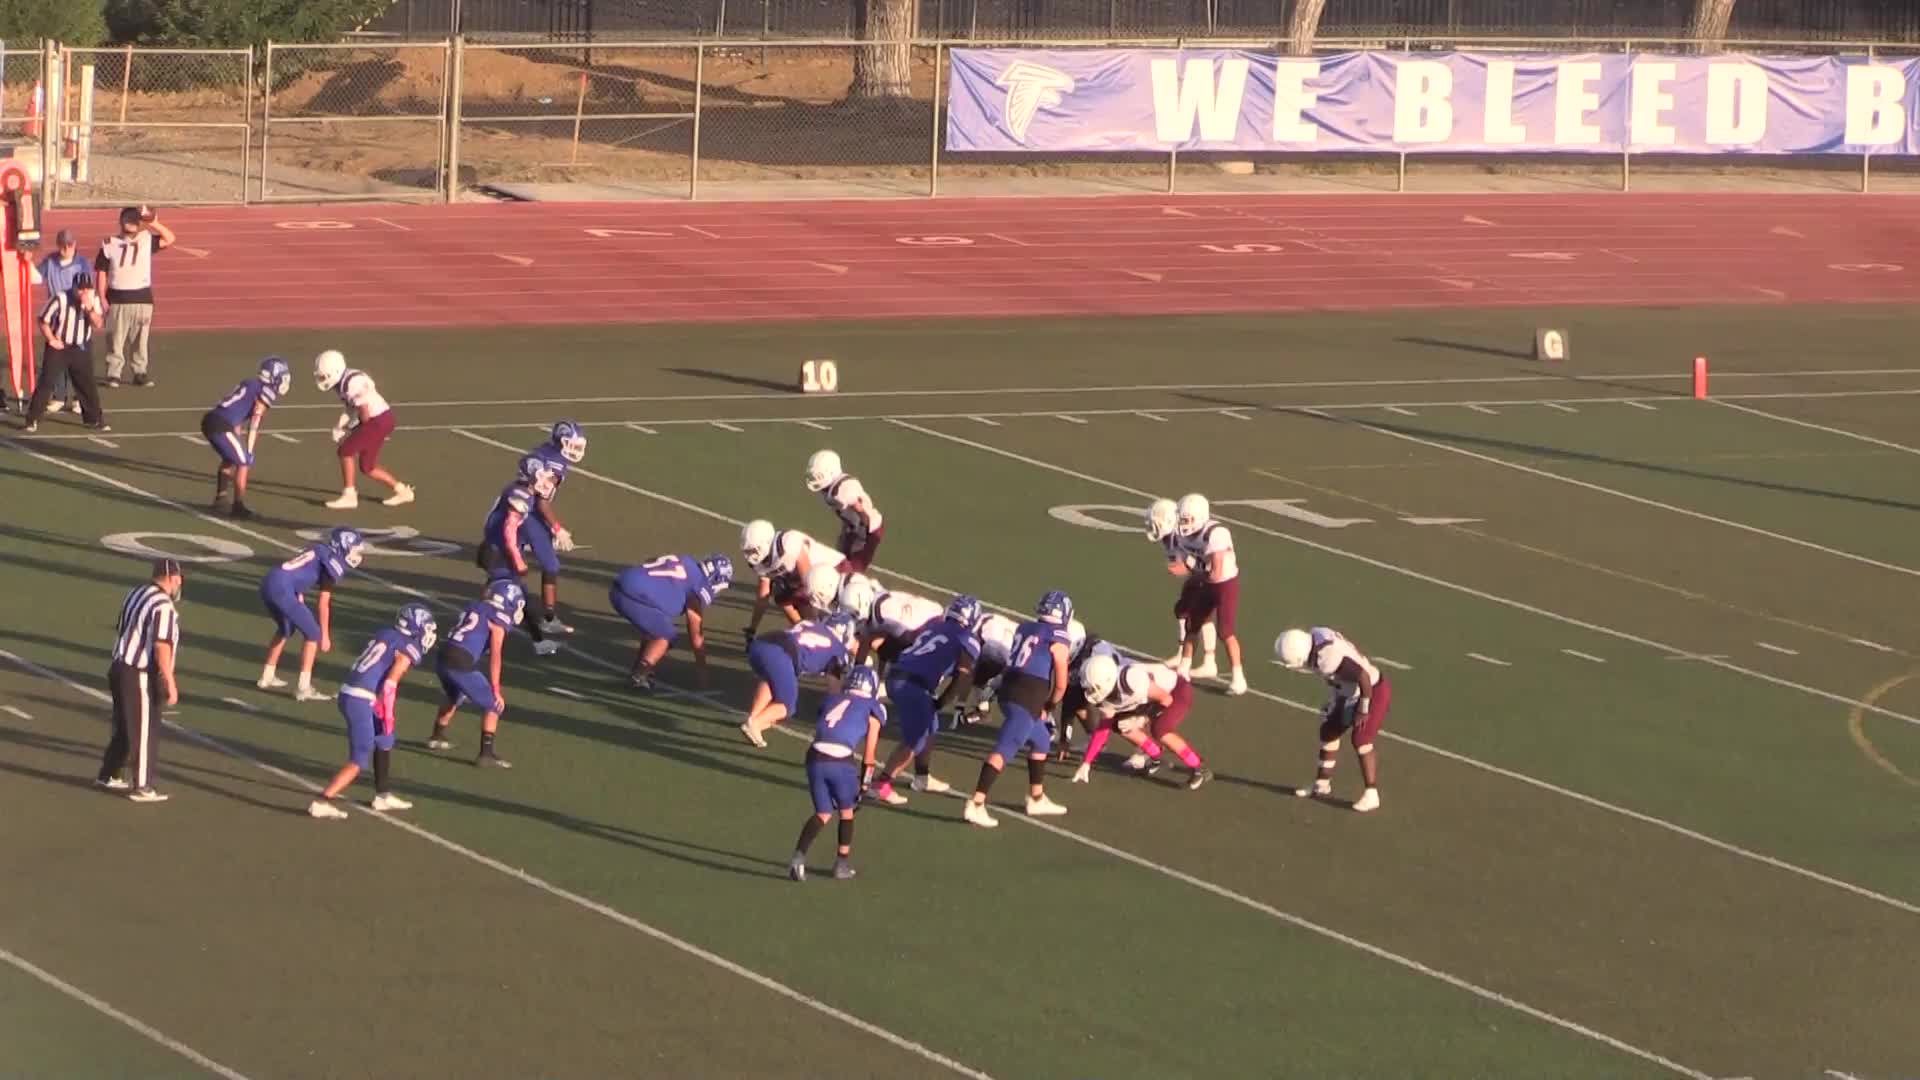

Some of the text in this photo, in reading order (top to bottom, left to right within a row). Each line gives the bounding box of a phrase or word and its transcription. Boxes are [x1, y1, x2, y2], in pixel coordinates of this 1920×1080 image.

[1150, 57, 1906, 145] WE BLEED B
[118, 242, 140, 268] 77
[1543, 329, 1564, 359] G
[801, 360, 838, 392] 10
[825, 699, 852, 729] 4
